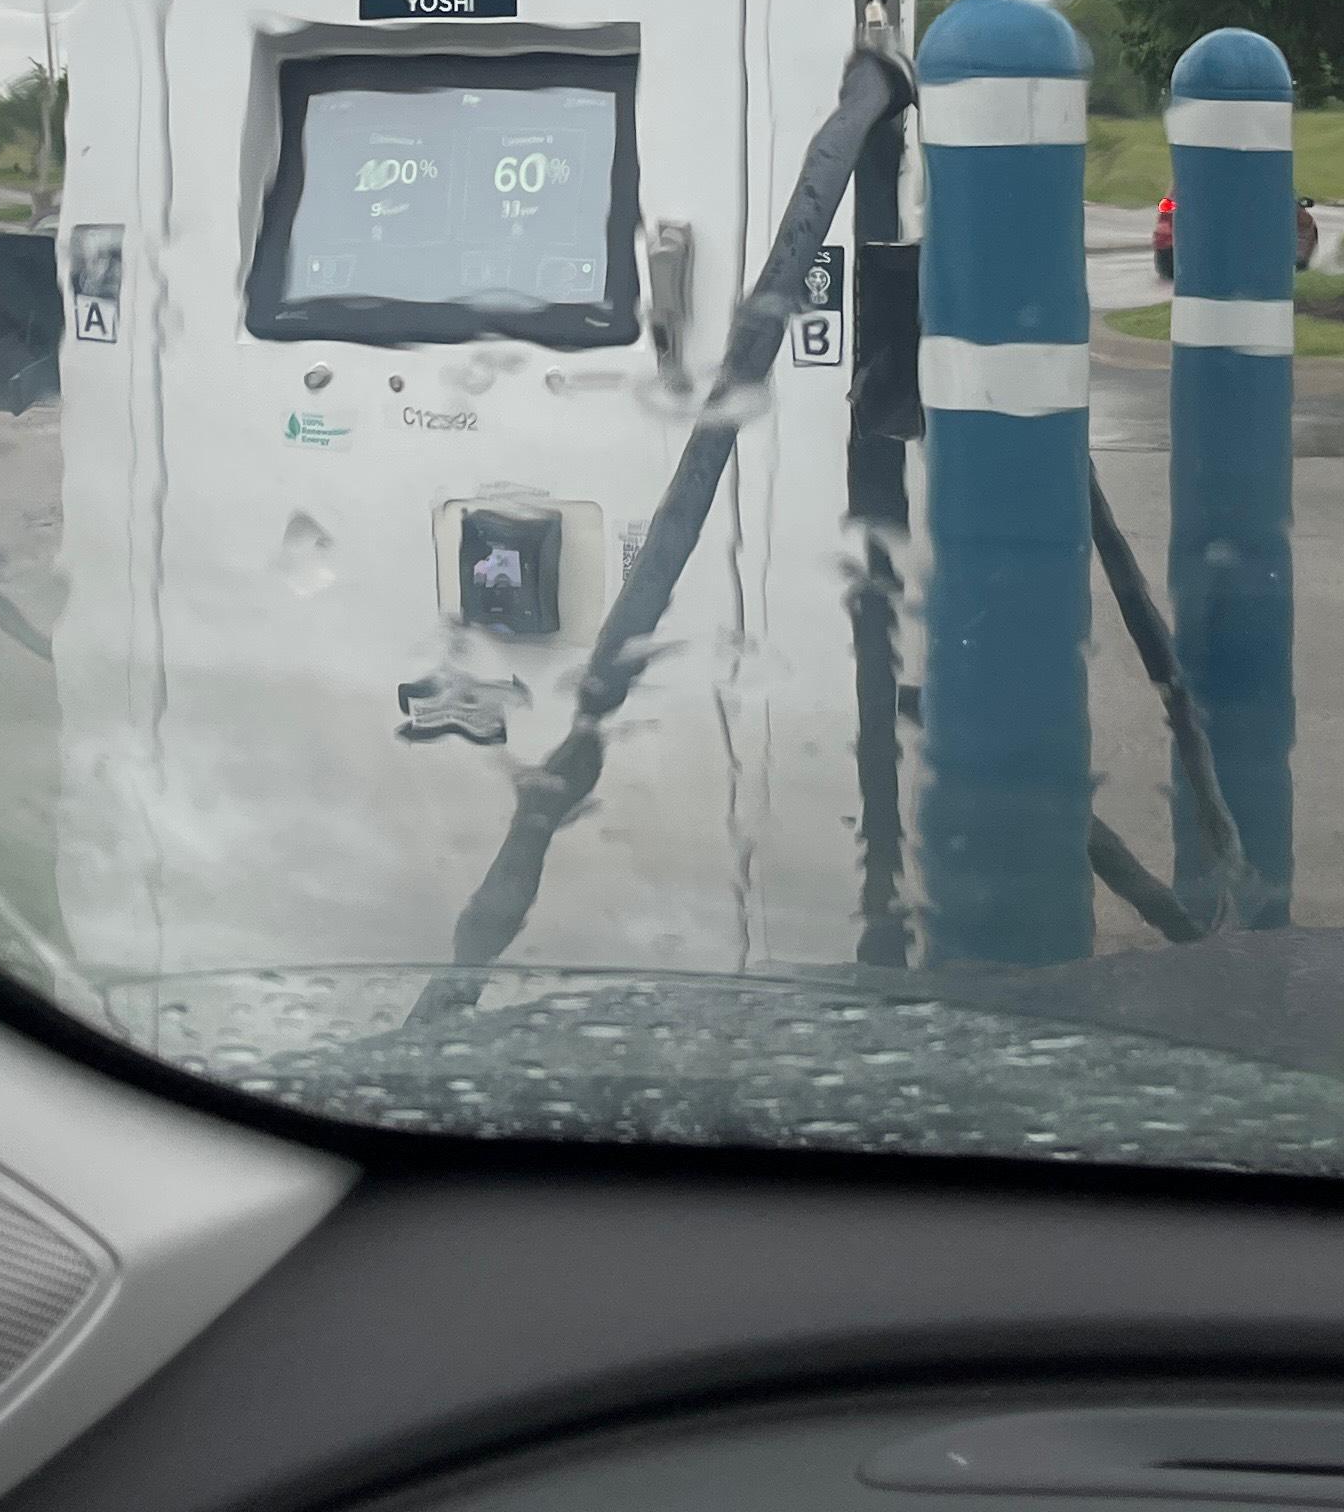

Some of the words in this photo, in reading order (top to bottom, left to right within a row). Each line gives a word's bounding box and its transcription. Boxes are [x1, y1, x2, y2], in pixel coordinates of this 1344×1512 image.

[84, 302, 107, 334] A
[802, 318, 830, 356] B
[403, 407, 479, 431] C1292
